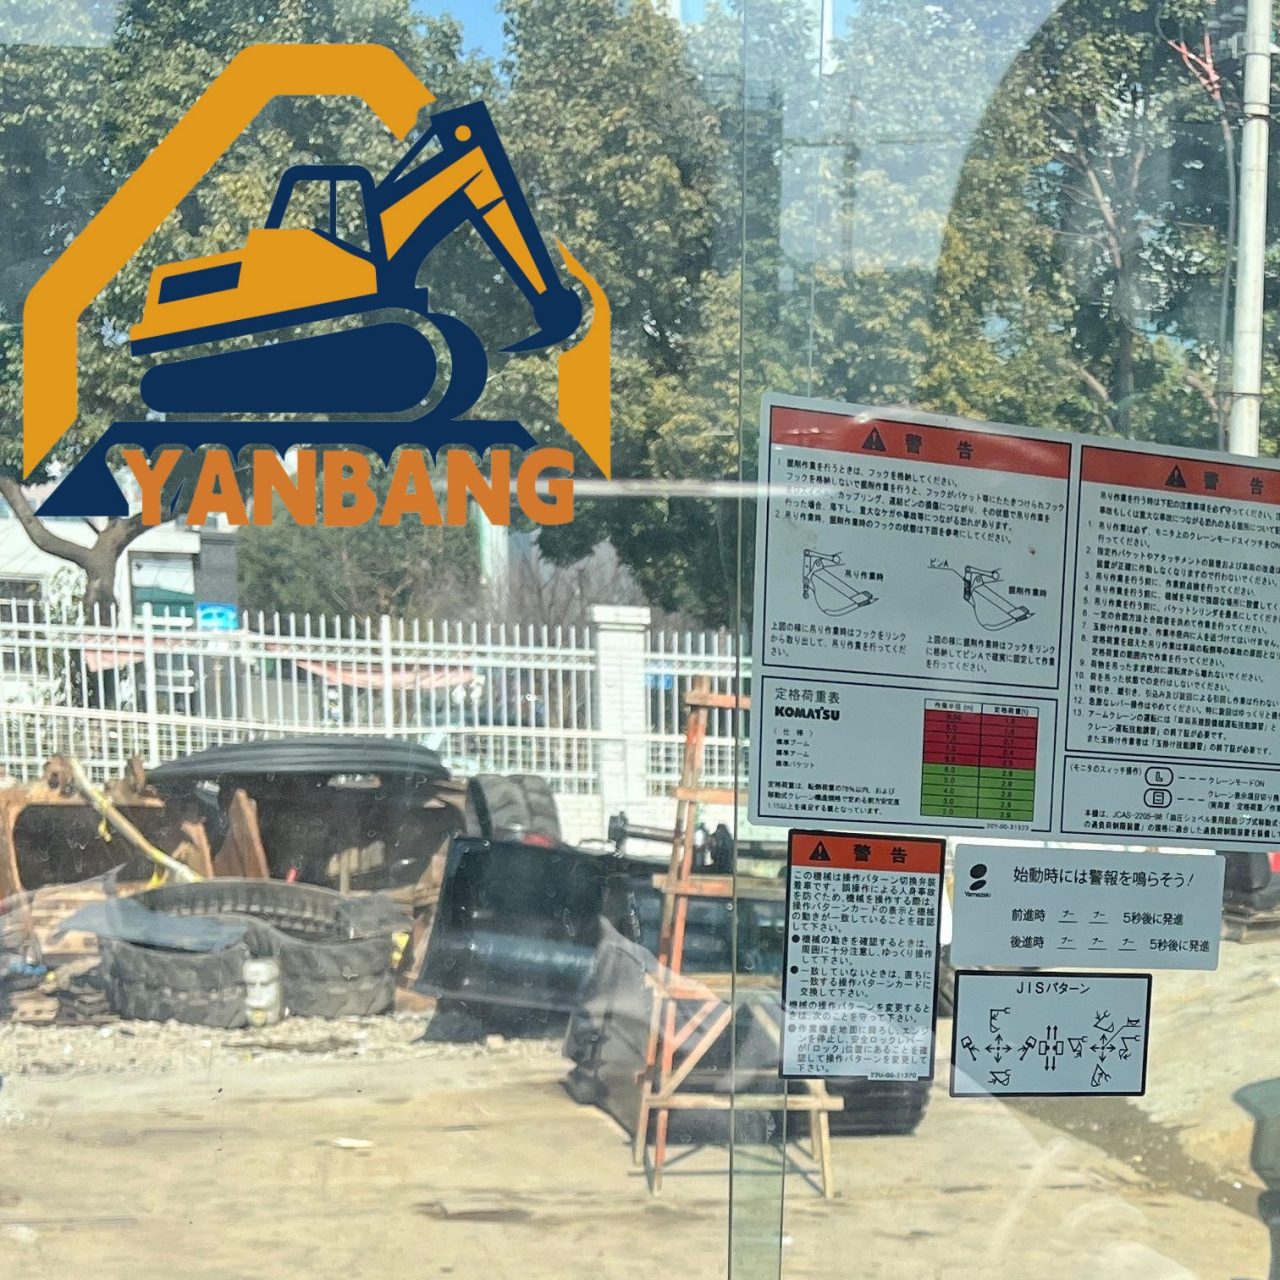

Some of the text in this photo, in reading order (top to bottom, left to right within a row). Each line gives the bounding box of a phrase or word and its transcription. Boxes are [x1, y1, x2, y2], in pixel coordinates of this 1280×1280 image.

[906, 434, 974, 460] 警告
[1204, 471, 1265, 496] 警告
[775, 688, 840, 704] 定格荷重表
[774, 706, 840, 721] KOMATSU
[853, 844, 908, 864] 警告
[1011, 908, 1046, 922] 前進時
[1123, 912, 1184, 926] 5秒後に発進
[1010, 936, 1044, 949] 後進時
[1150, 939, 1210, 953] 5秒後に発進
[1016, 981, 1090, 995] JISパターン
